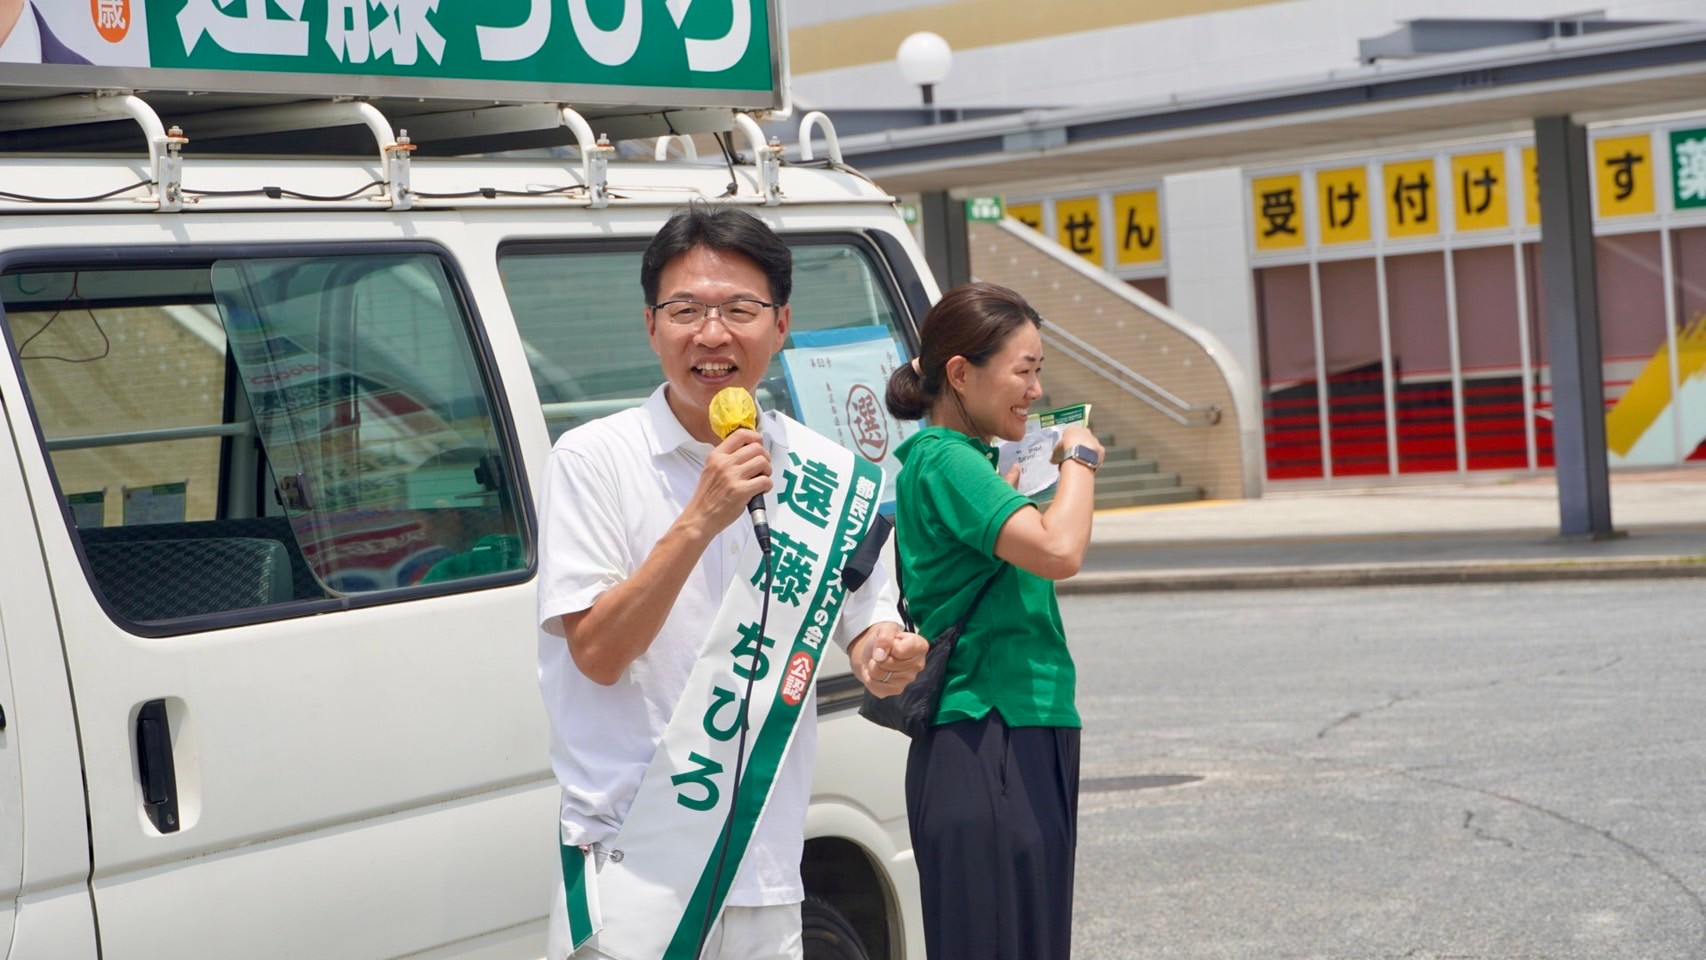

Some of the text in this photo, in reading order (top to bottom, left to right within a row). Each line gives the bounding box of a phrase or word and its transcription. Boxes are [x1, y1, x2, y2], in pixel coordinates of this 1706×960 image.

[1262, 151, 1644, 237] 受け付けす
[1019, 206, 1155, 254] せん
[851, 394, 885, 449] 選
[801, 476, 877, 650] 都民ファーストの会
[670, 451, 839, 811] 遠藤ちひろ
[782, 656, 811, 702] 公認
